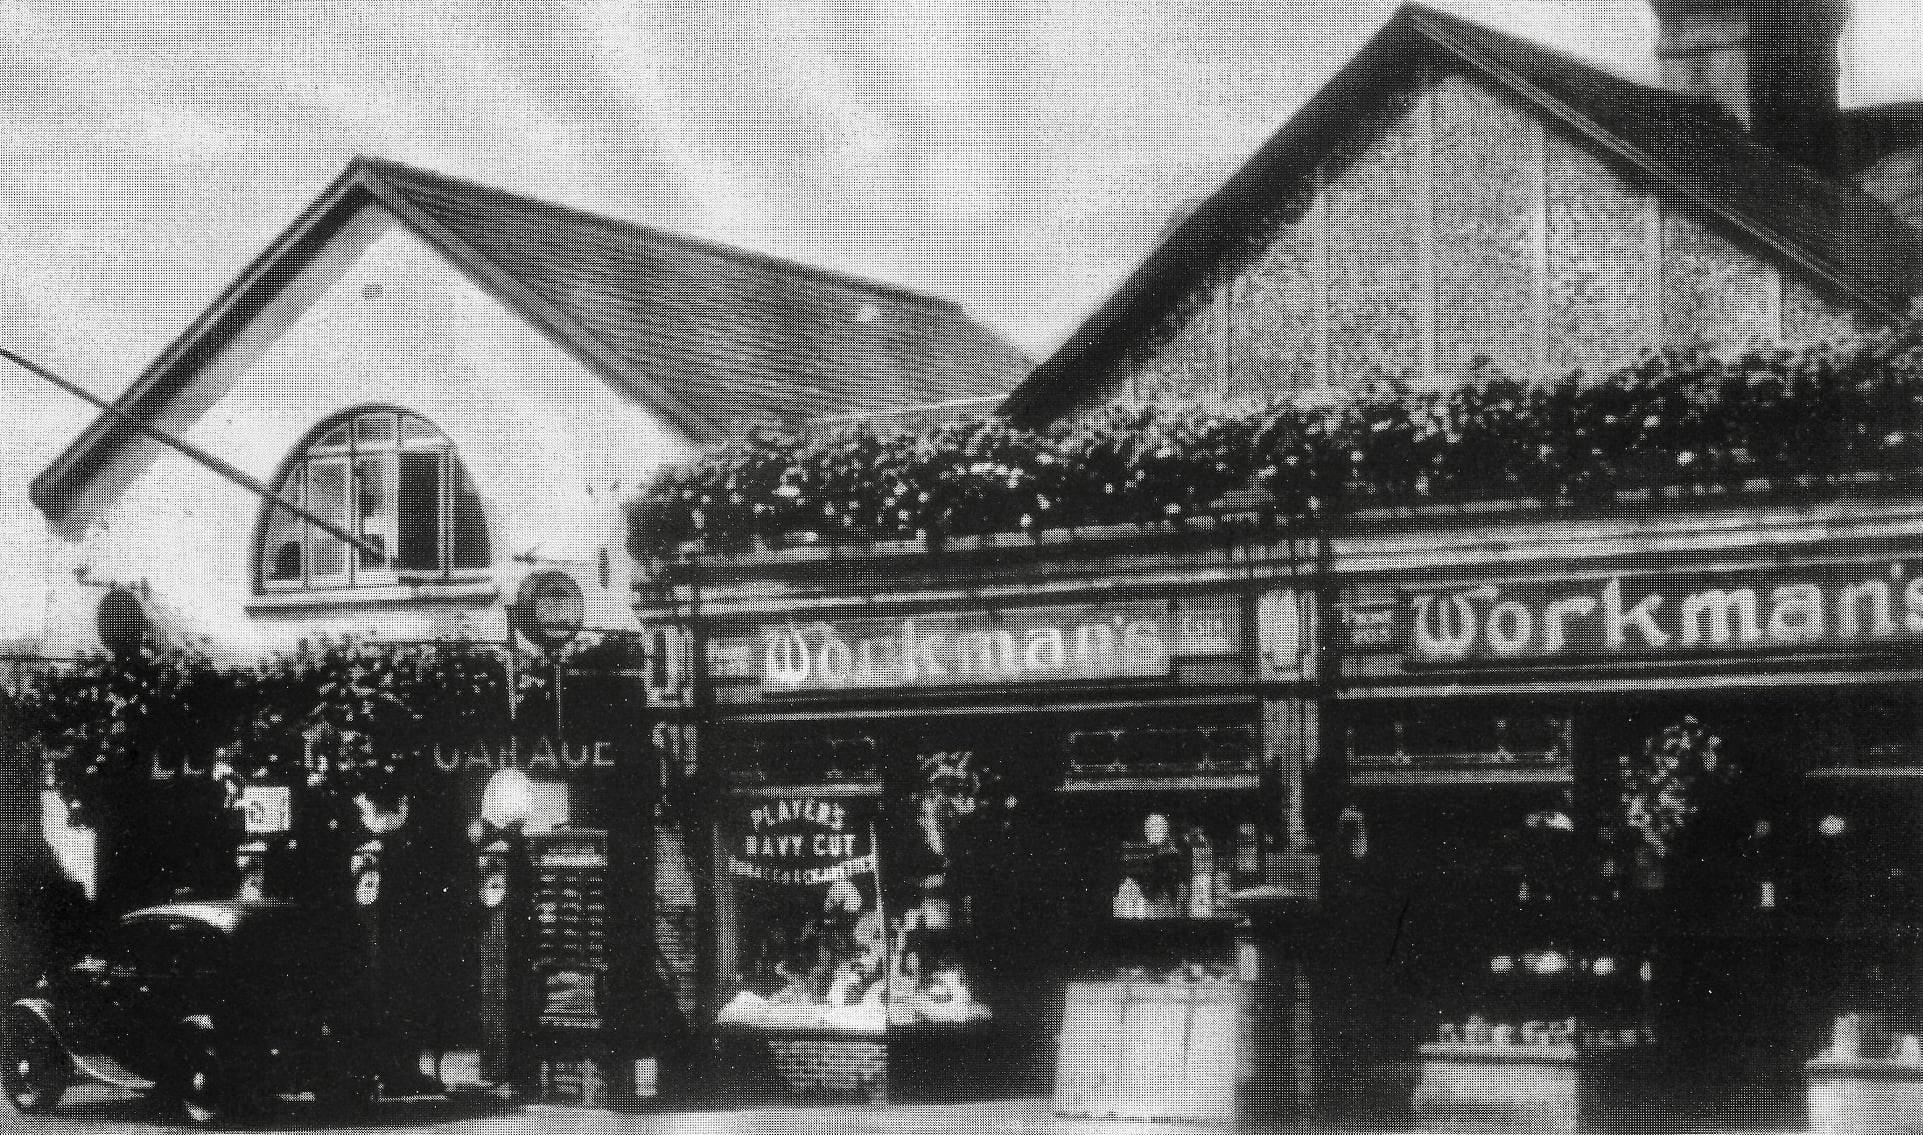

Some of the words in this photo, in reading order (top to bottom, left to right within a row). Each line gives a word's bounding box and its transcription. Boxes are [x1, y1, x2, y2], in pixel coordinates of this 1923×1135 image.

[762, 616, 1164, 685] Workman's
[750, 798, 845, 832] PLAYER'S
[745, 834, 804, 857] NAVY
[813, 833, 857, 857] CUT
